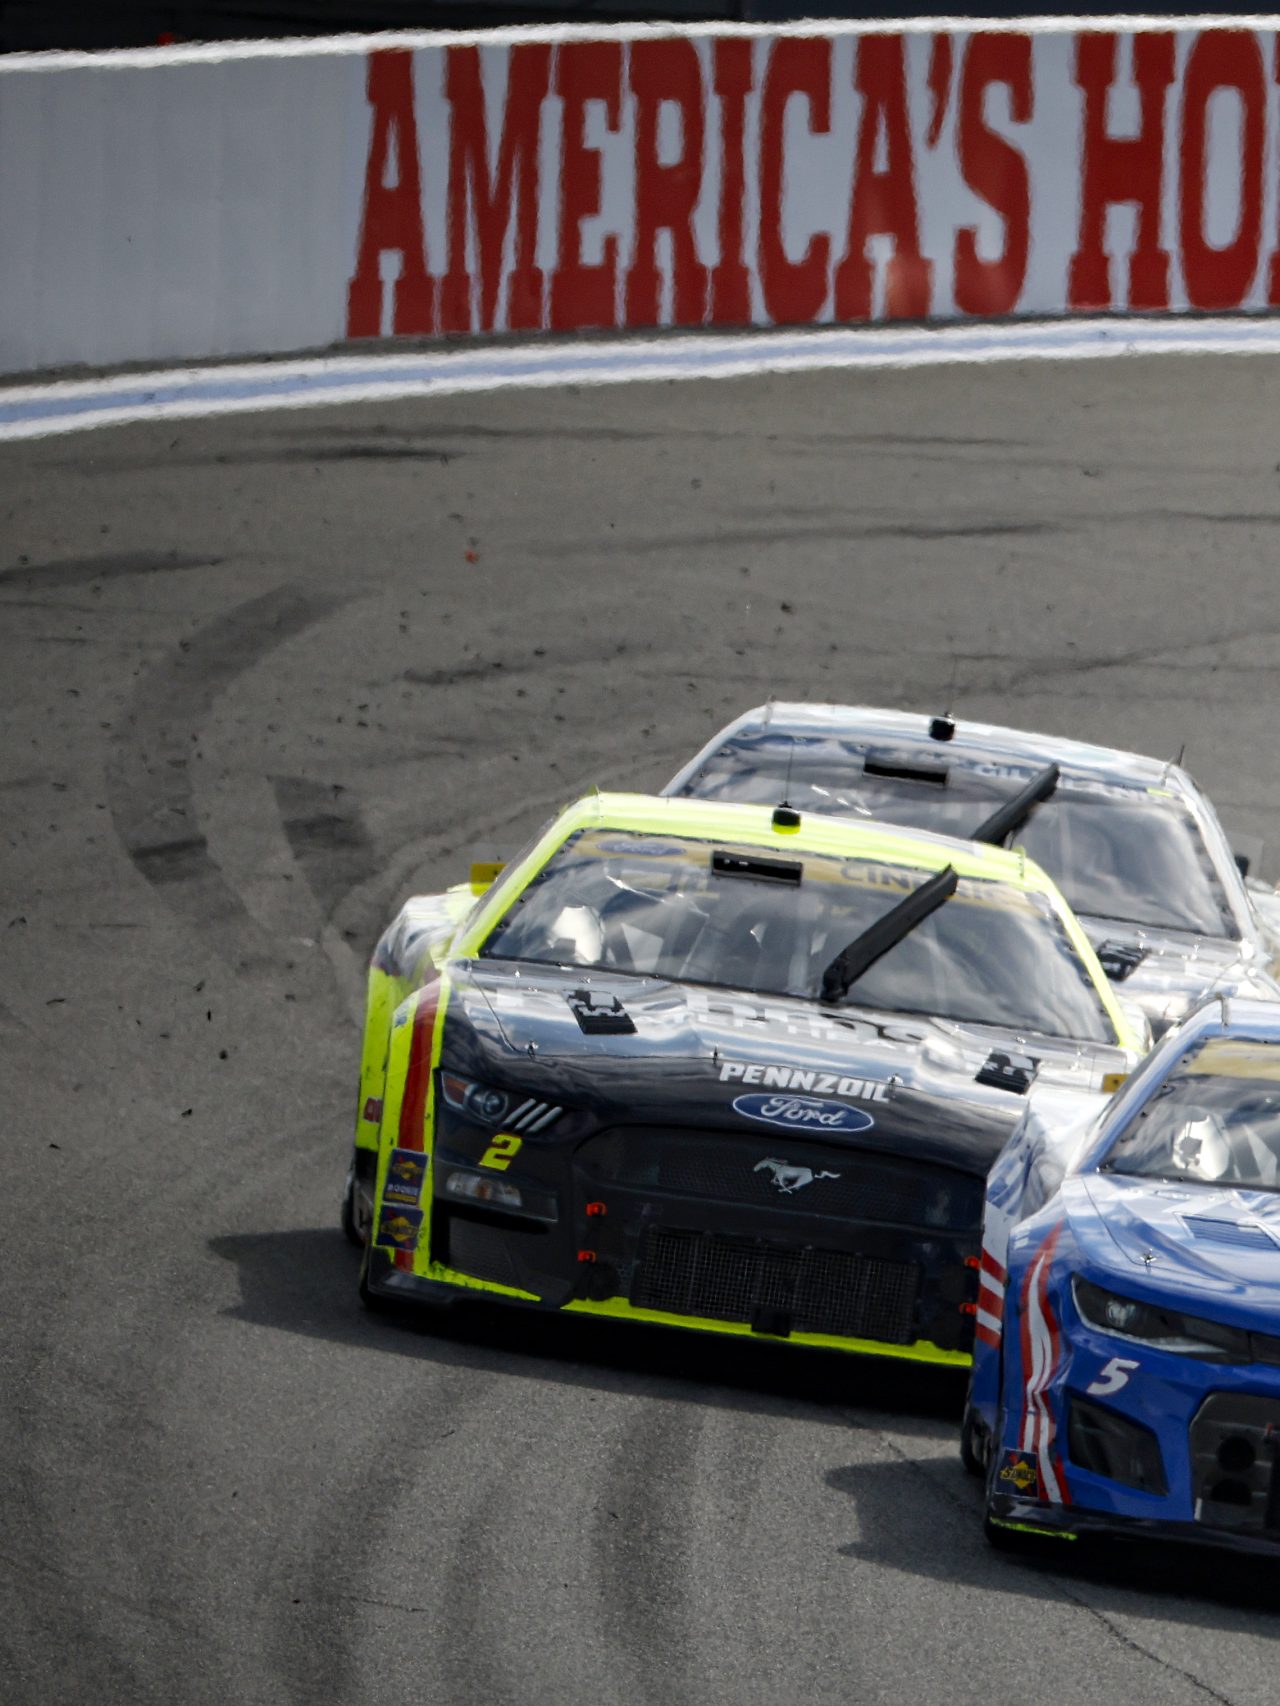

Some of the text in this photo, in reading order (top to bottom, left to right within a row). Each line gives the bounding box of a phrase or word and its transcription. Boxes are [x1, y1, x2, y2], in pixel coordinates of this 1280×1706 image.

[347, 31, 1034, 338] AMERICA'S
[719, 1062, 890, 1103] PENNZOIL
[760, 1096, 848, 1126] Ford
[479, 1133, 524, 1172] 2
[1086, 1357, 1141, 1396] 5
